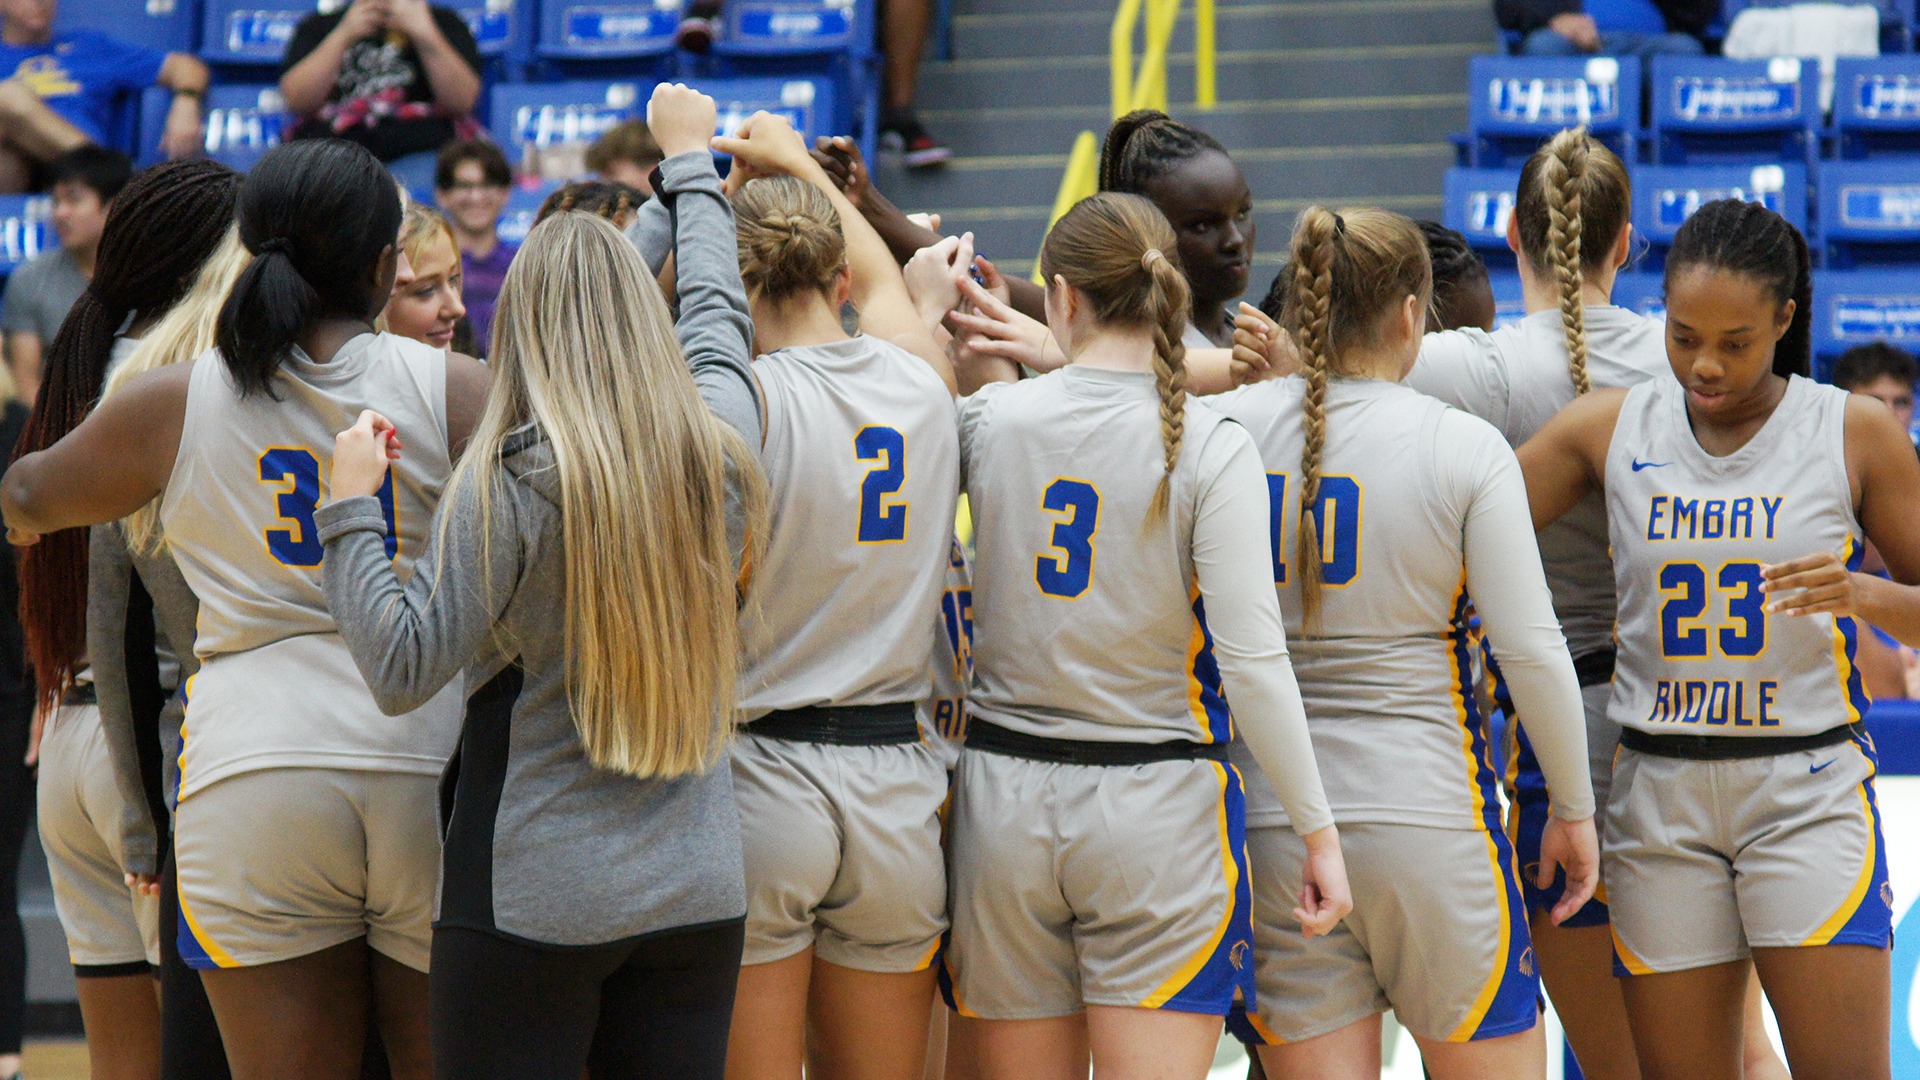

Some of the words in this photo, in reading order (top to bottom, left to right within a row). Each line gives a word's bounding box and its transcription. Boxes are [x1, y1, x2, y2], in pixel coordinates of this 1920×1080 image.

[257, 444, 400, 569] 3
[852, 423, 910, 545] 2
[1034, 476, 1102, 601] 3
[1646, 495, 1787, 542] EMBRY
[1657, 559, 1768, 660] 23
[1647, 678, 1781, 727] RIDDLE
